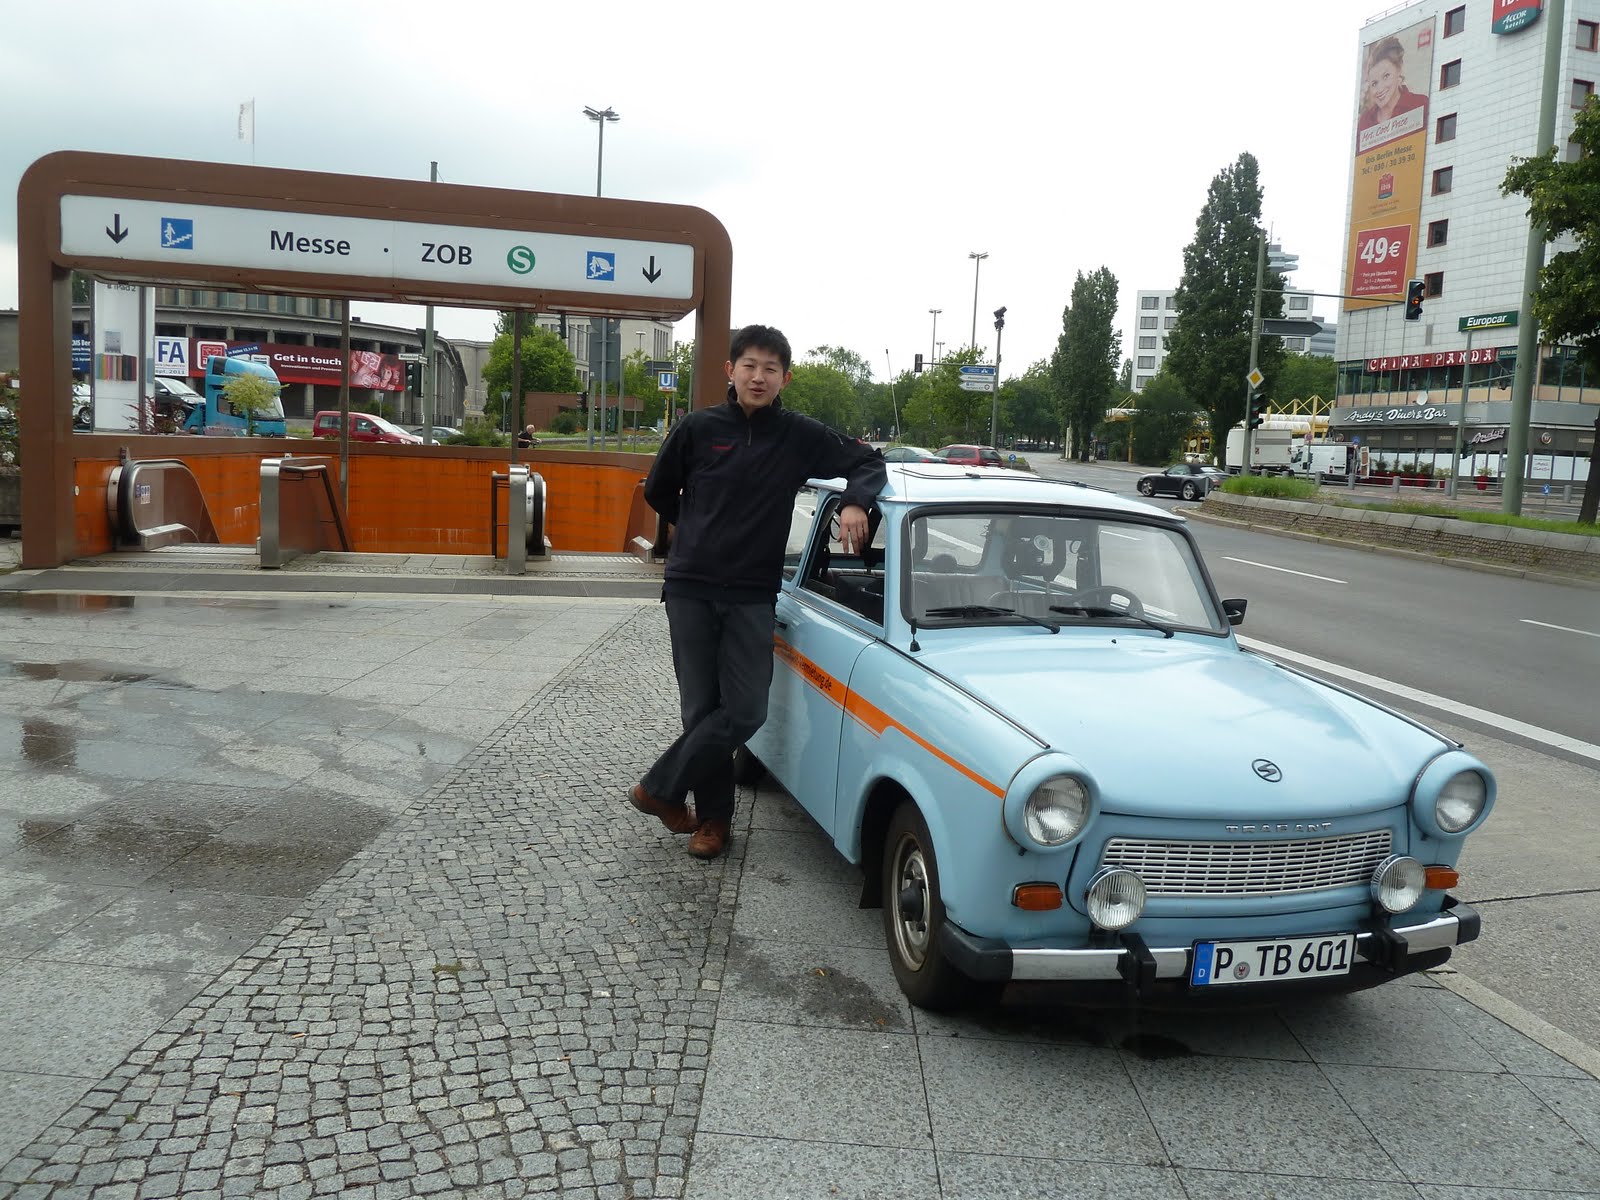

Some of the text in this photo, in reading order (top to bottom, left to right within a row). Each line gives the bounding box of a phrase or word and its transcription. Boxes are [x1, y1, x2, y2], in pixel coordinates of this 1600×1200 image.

[1376, 150, 1393, 161] Berlin
[269, 230, 534, 271] Messe ZOB S
[1466, 315, 1507, 327] Europcar
[273, 353, 342, 366] Get in touch
[661, 373, 671, 386] U
[1344, 410, 1384, 422] Andy's
[1424, 408, 1447, 420] Bar
[1214, 938, 1348, 979] P TB 601
[1198, 968, 1206, 978] D
